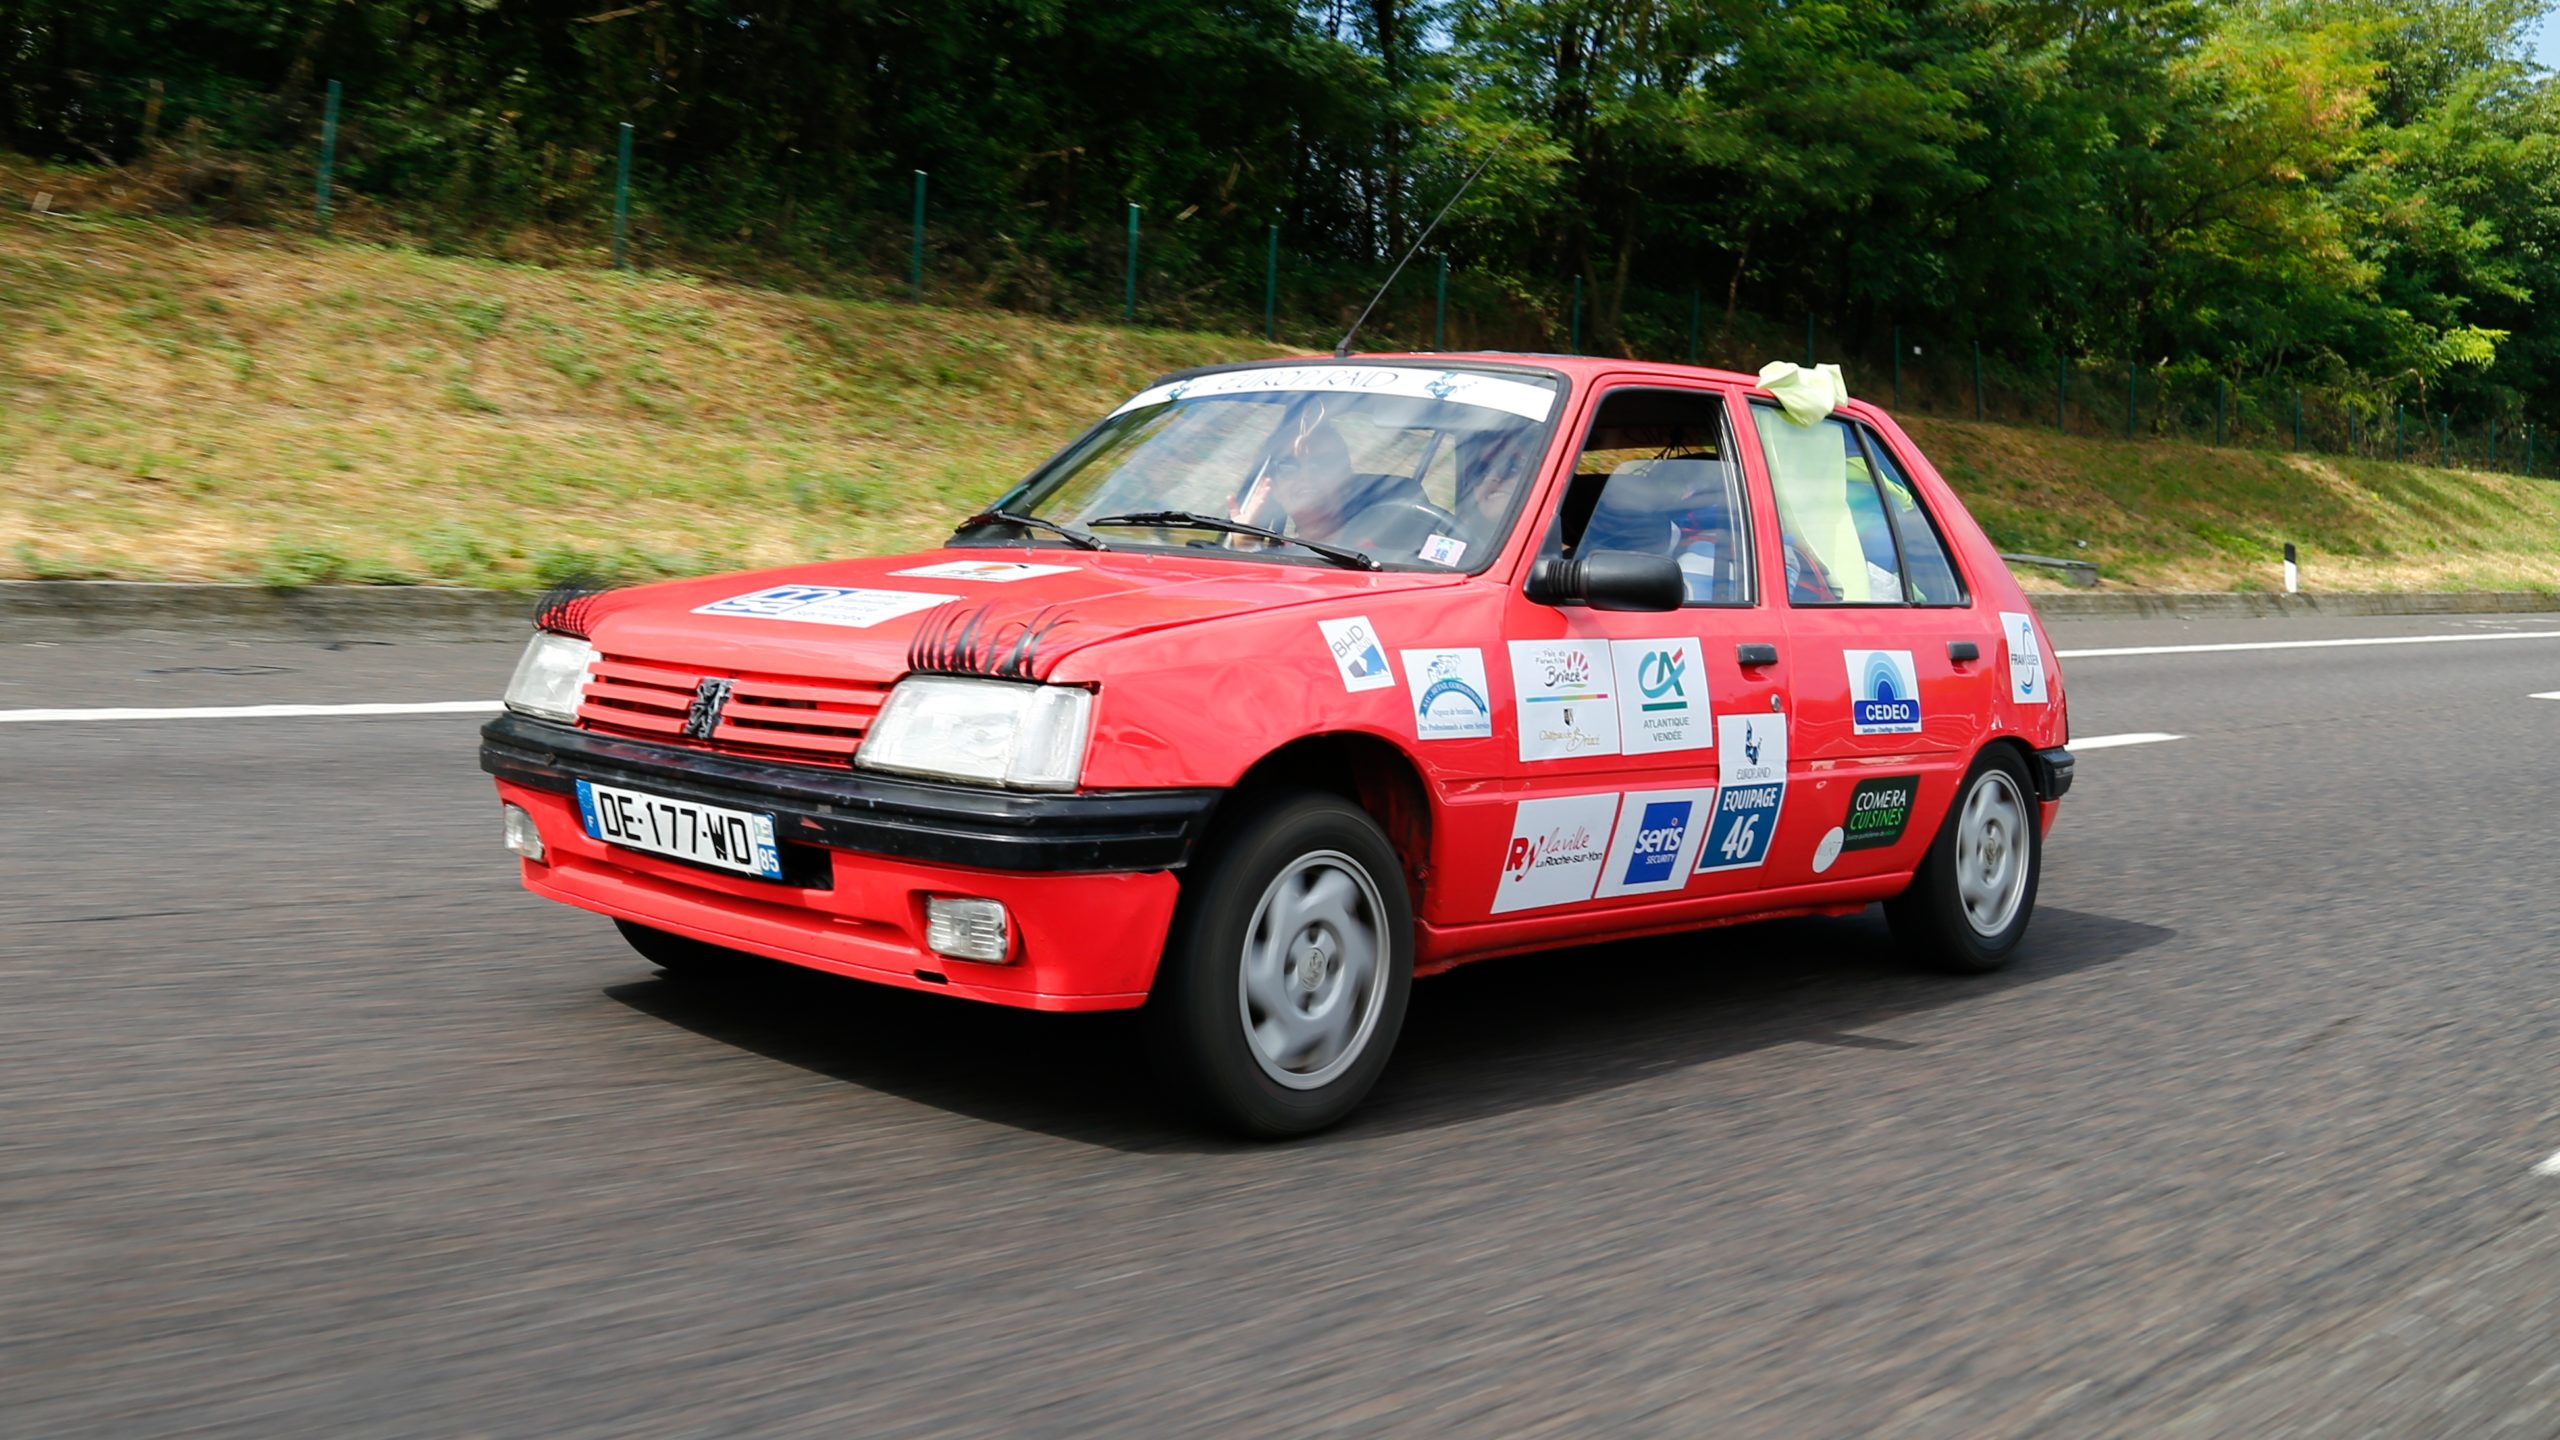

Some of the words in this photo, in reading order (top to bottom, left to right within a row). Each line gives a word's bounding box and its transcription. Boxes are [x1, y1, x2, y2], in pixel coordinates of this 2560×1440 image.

[1331, 625, 1365, 658] BHD
[1643, 717, 1690, 729] ATLANTIQUE
[1865, 703, 1910, 721] CEDEO
[1652, 731, 1683, 742] VENDÉE
[1722, 787, 1778, 812] EQUIPAGE
[1856, 789, 1907, 812] COMERA
[1850, 807, 1904, 830] CUISINES
[1720, 814, 1760, 860] 46
[759, 847, 780, 873] 85
